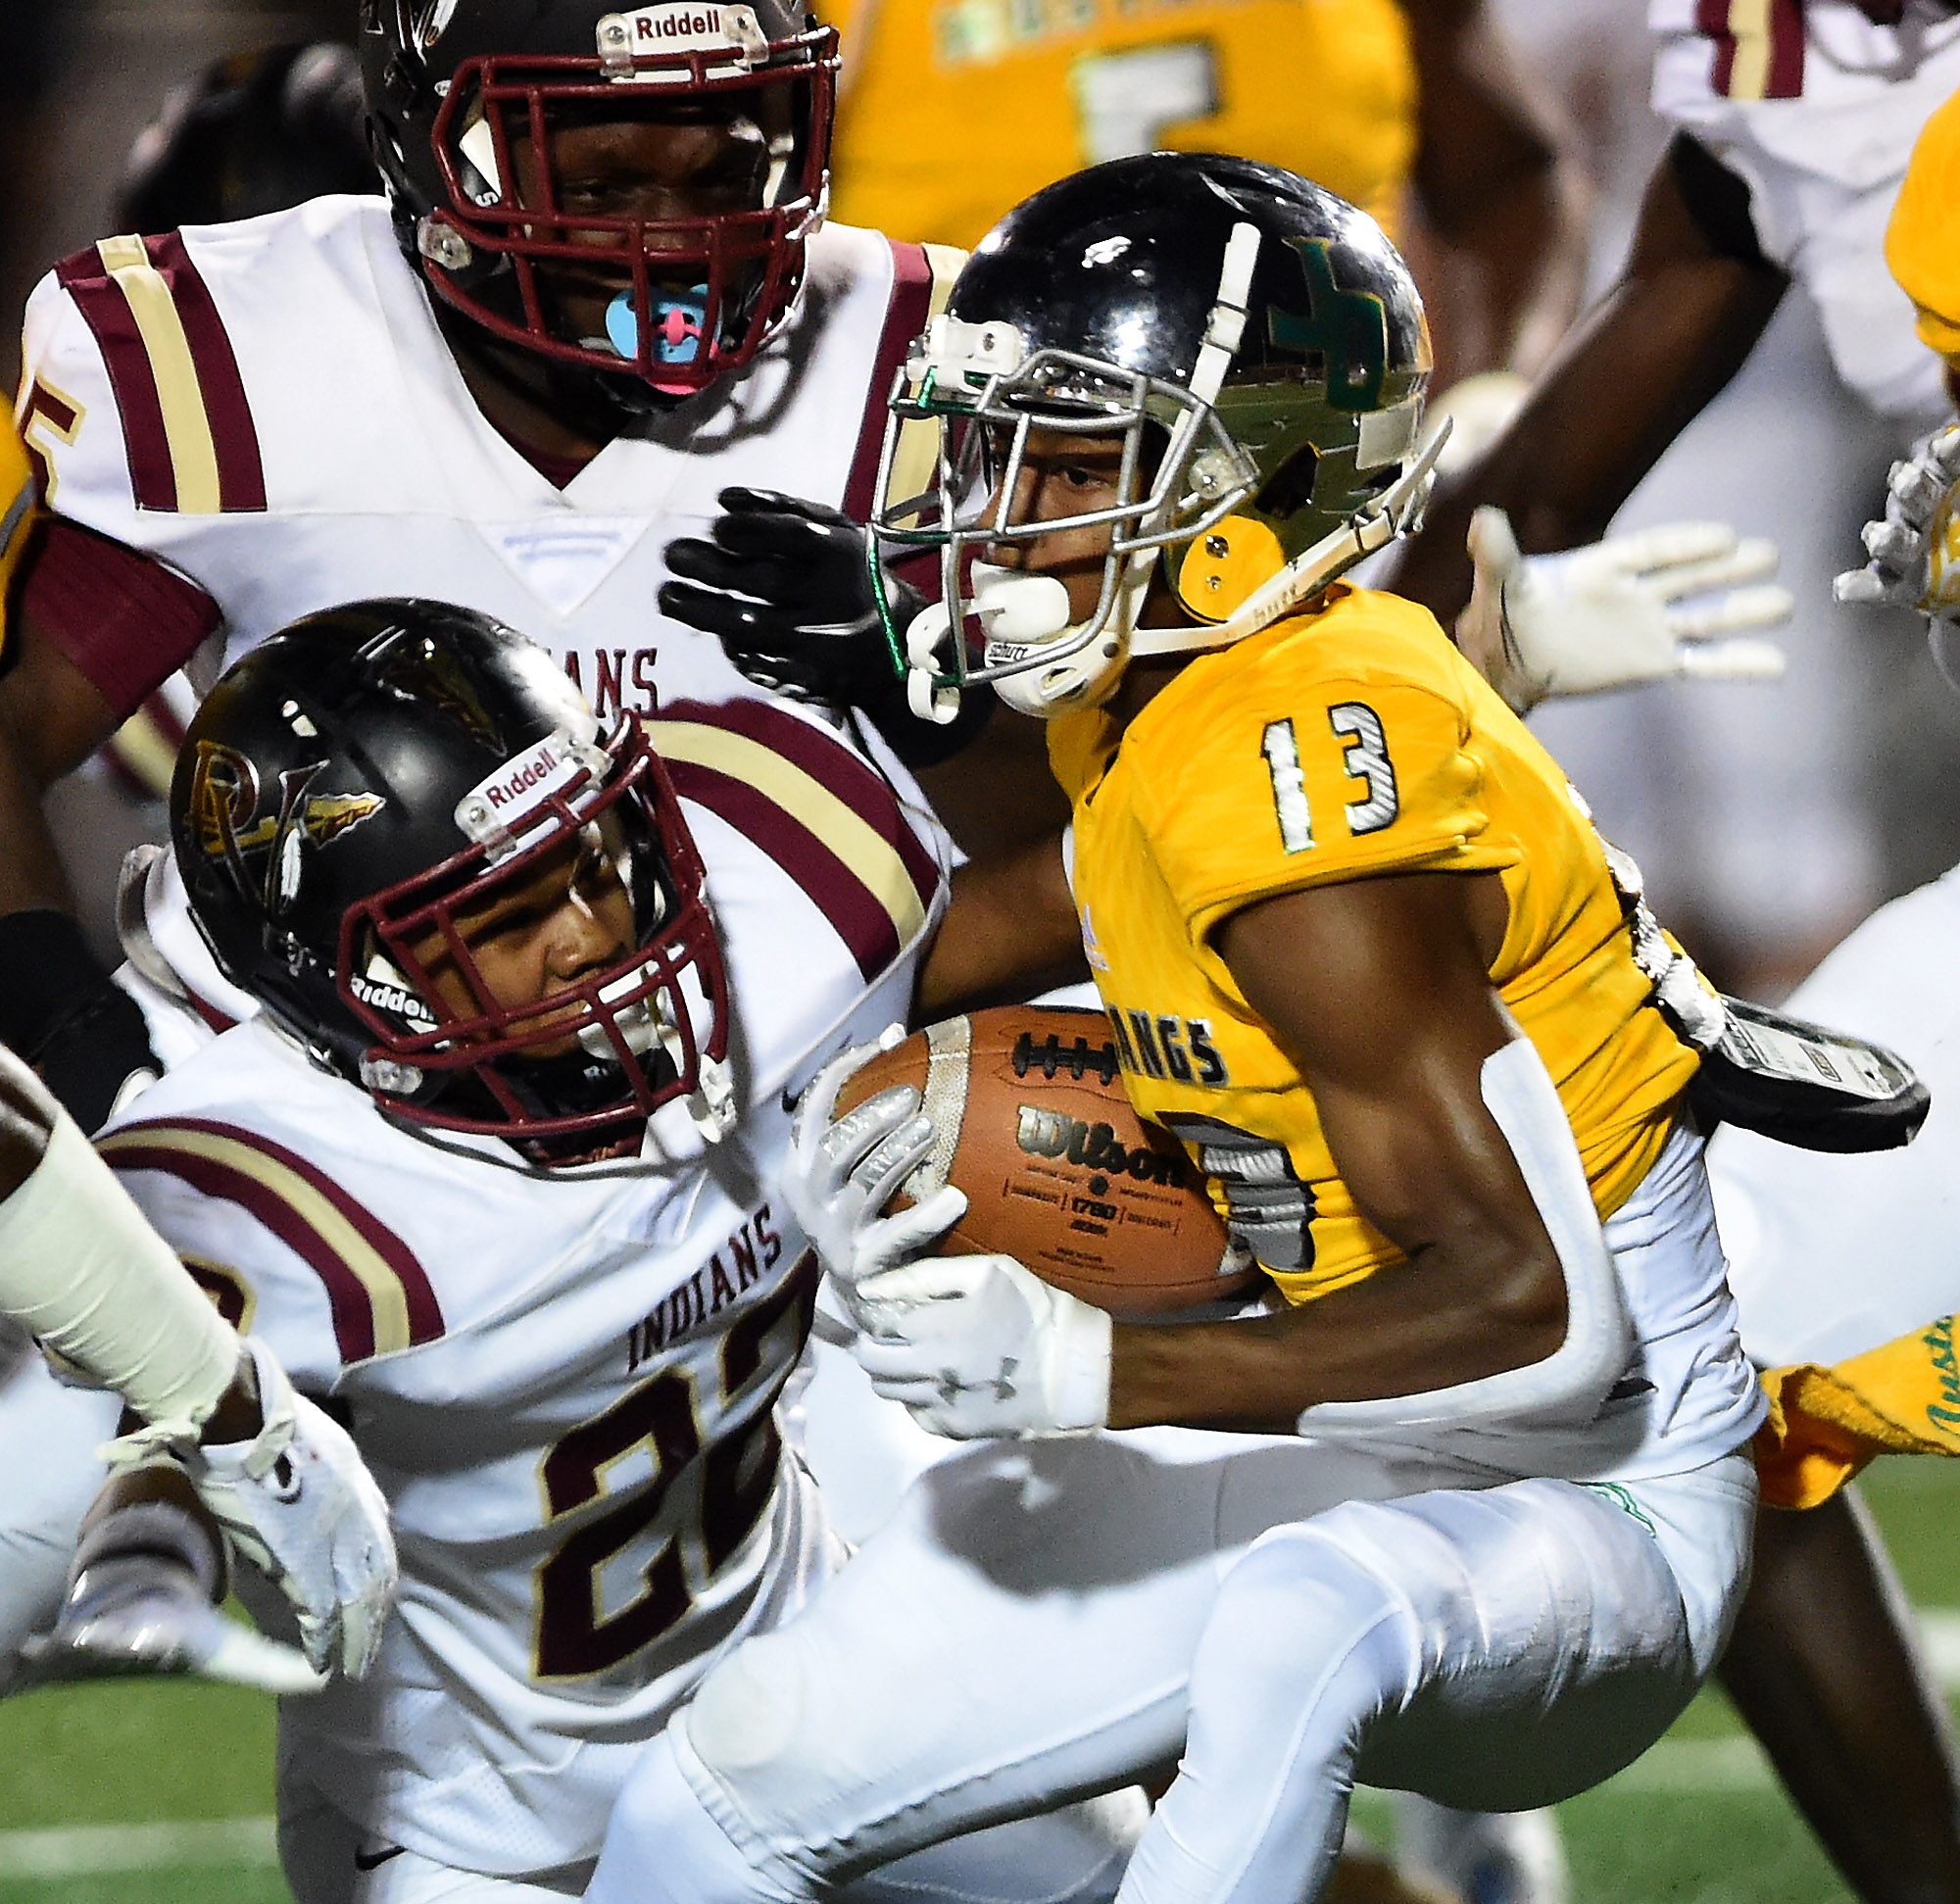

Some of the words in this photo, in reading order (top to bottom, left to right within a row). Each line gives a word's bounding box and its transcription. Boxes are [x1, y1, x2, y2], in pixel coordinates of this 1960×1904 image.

[636, 9, 720, 40] Riddell
[485, 747, 558, 809] Riddell
[1260, 701, 1399, 855] 13
[351, 973, 434, 1021] Riddel
[1017, 1103, 1187, 1190] Wilson
[628, 1201, 782, 1372] INDIANS
[532, 1242, 820, 1683] 22
